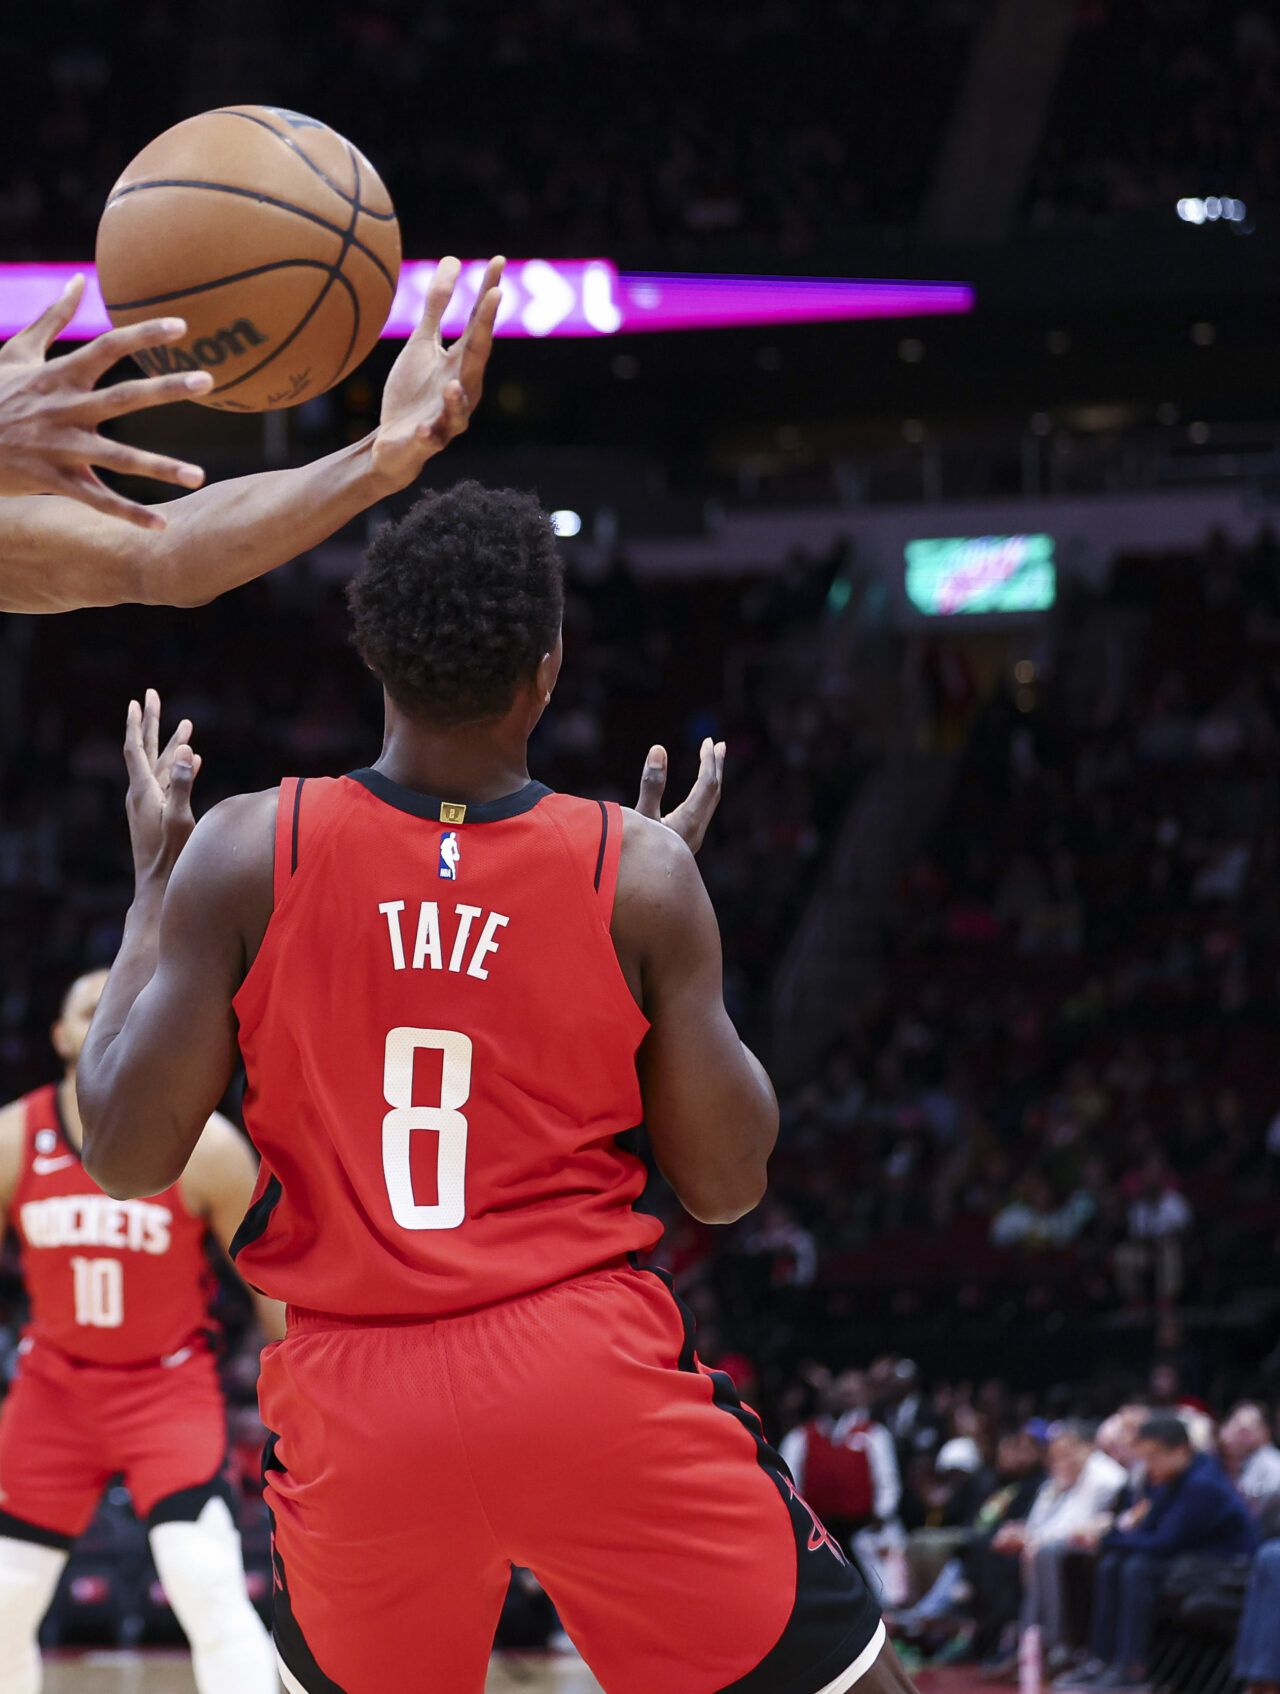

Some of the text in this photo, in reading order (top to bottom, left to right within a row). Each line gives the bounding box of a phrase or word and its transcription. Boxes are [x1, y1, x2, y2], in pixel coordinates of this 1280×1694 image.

[378, 900, 510, 981] TATE
[382, 1026, 473, 1230] 8
[20, 1194, 172, 1254] ROCKETS
[71, 1257, 123, 1328] 10
